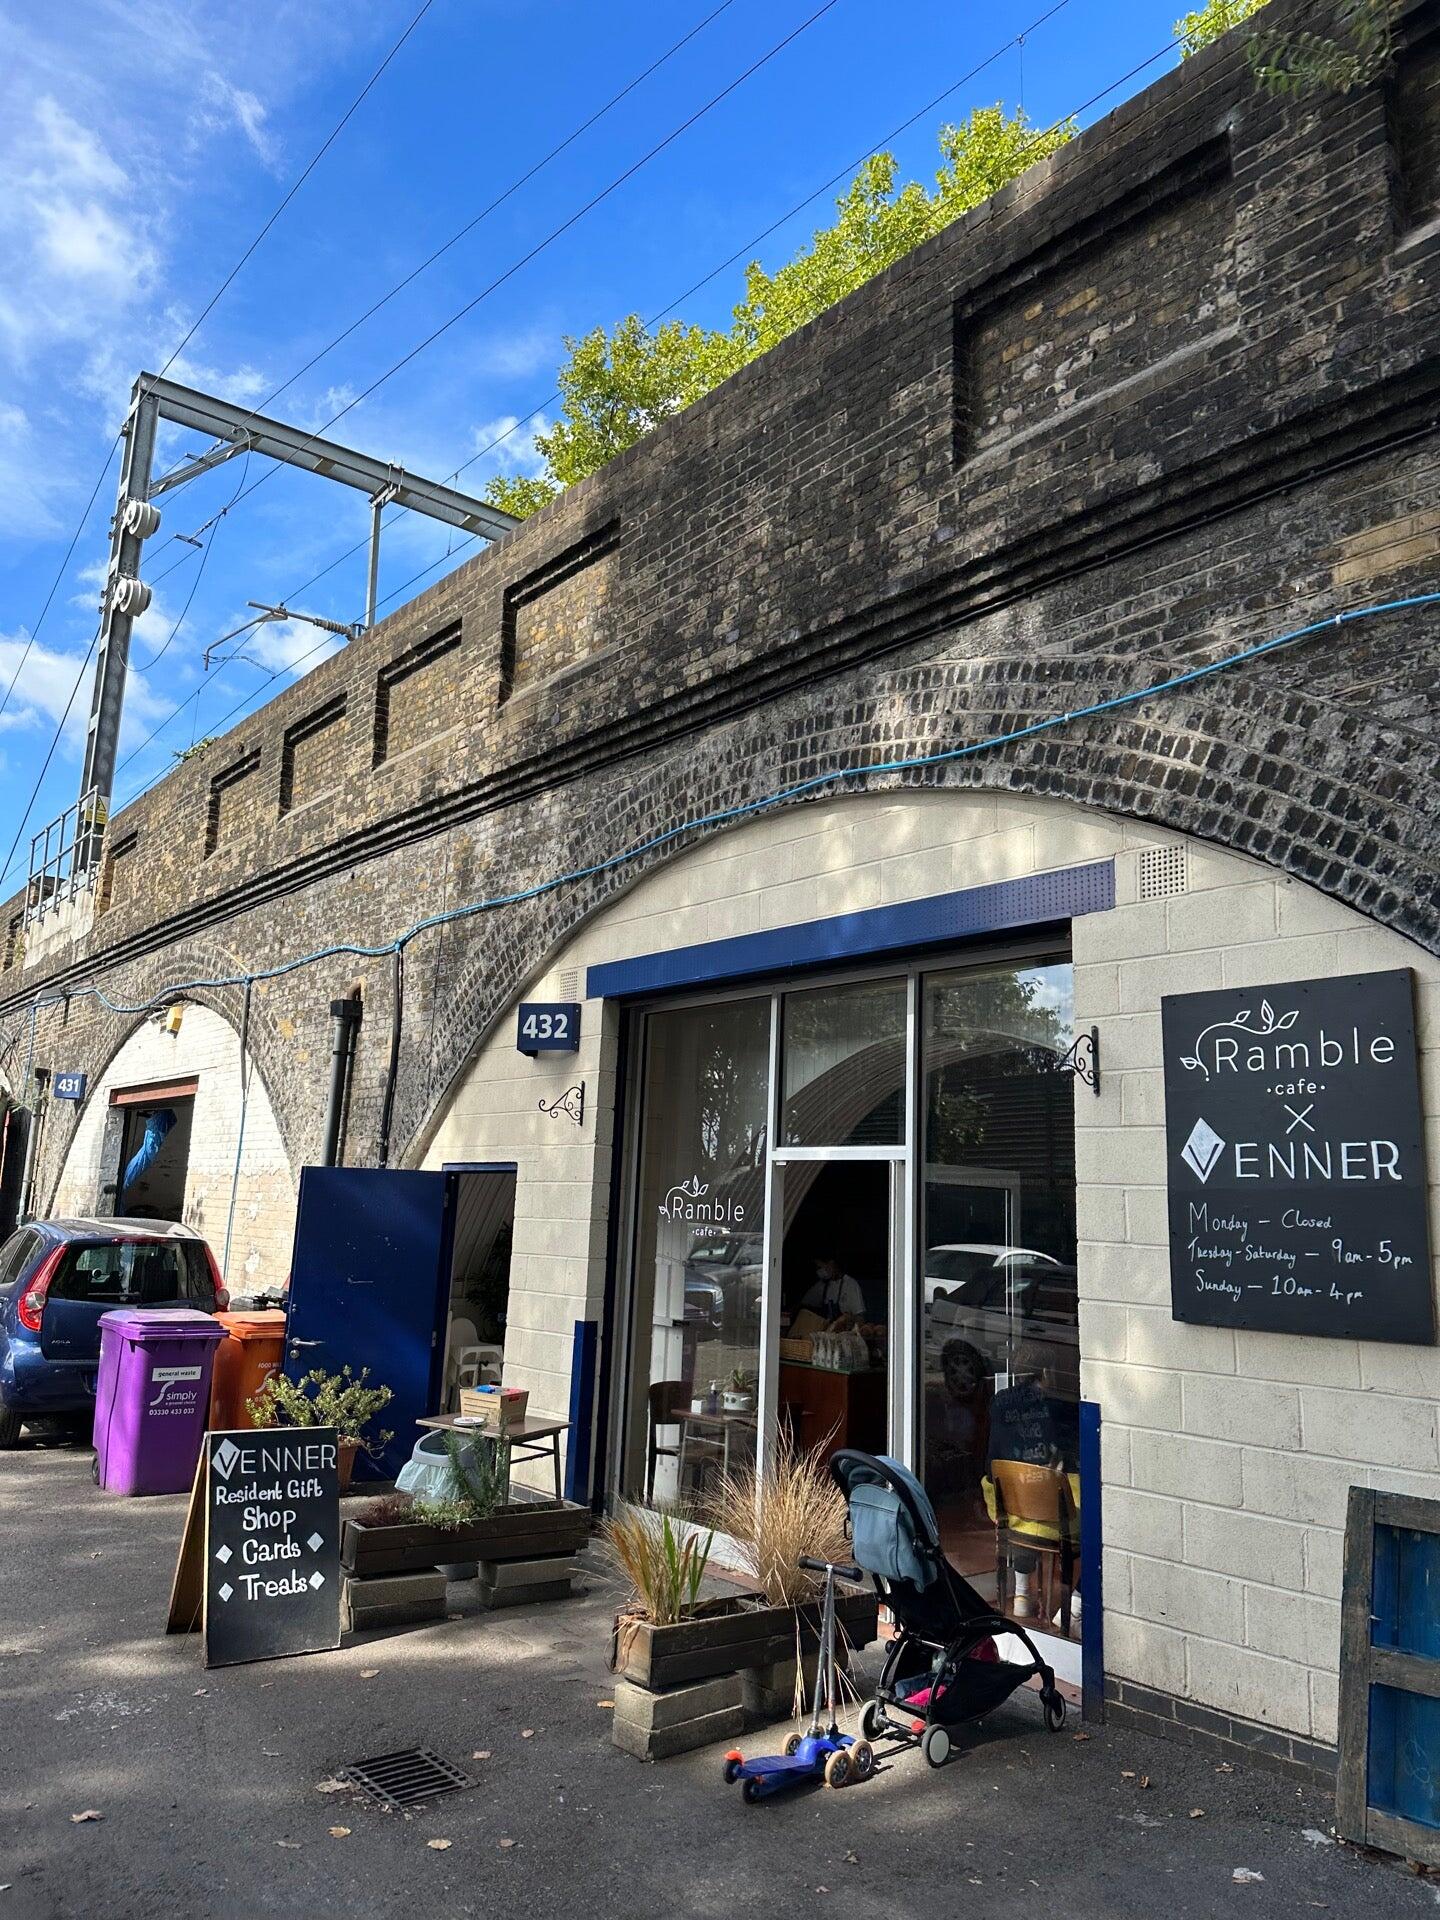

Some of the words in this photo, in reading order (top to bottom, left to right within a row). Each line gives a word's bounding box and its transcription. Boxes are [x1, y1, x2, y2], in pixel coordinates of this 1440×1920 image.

[522, 1013, 568, 1038] 432
[1216, 1026, 1395, 1073] Ramble
[58, 1078, 79, 1092] 431
[672, 1196, 744, 1222] Ramble
[1189, 1202, 1248, 1242] Monday
[1281, 1209, 1332, 1229] Closed
[1195, 1269, 1242, 1302] Sunday
[166, 1390, 198, 1401] simply
[216, 1481, 283, 1505] Resident
[287, 1478, 323, 1499] Gift
[243, 1506, 297, 1533] Shop
[242, 1535, 301, 1565] Cards
[238, 1568, 308, 1601] Treats
